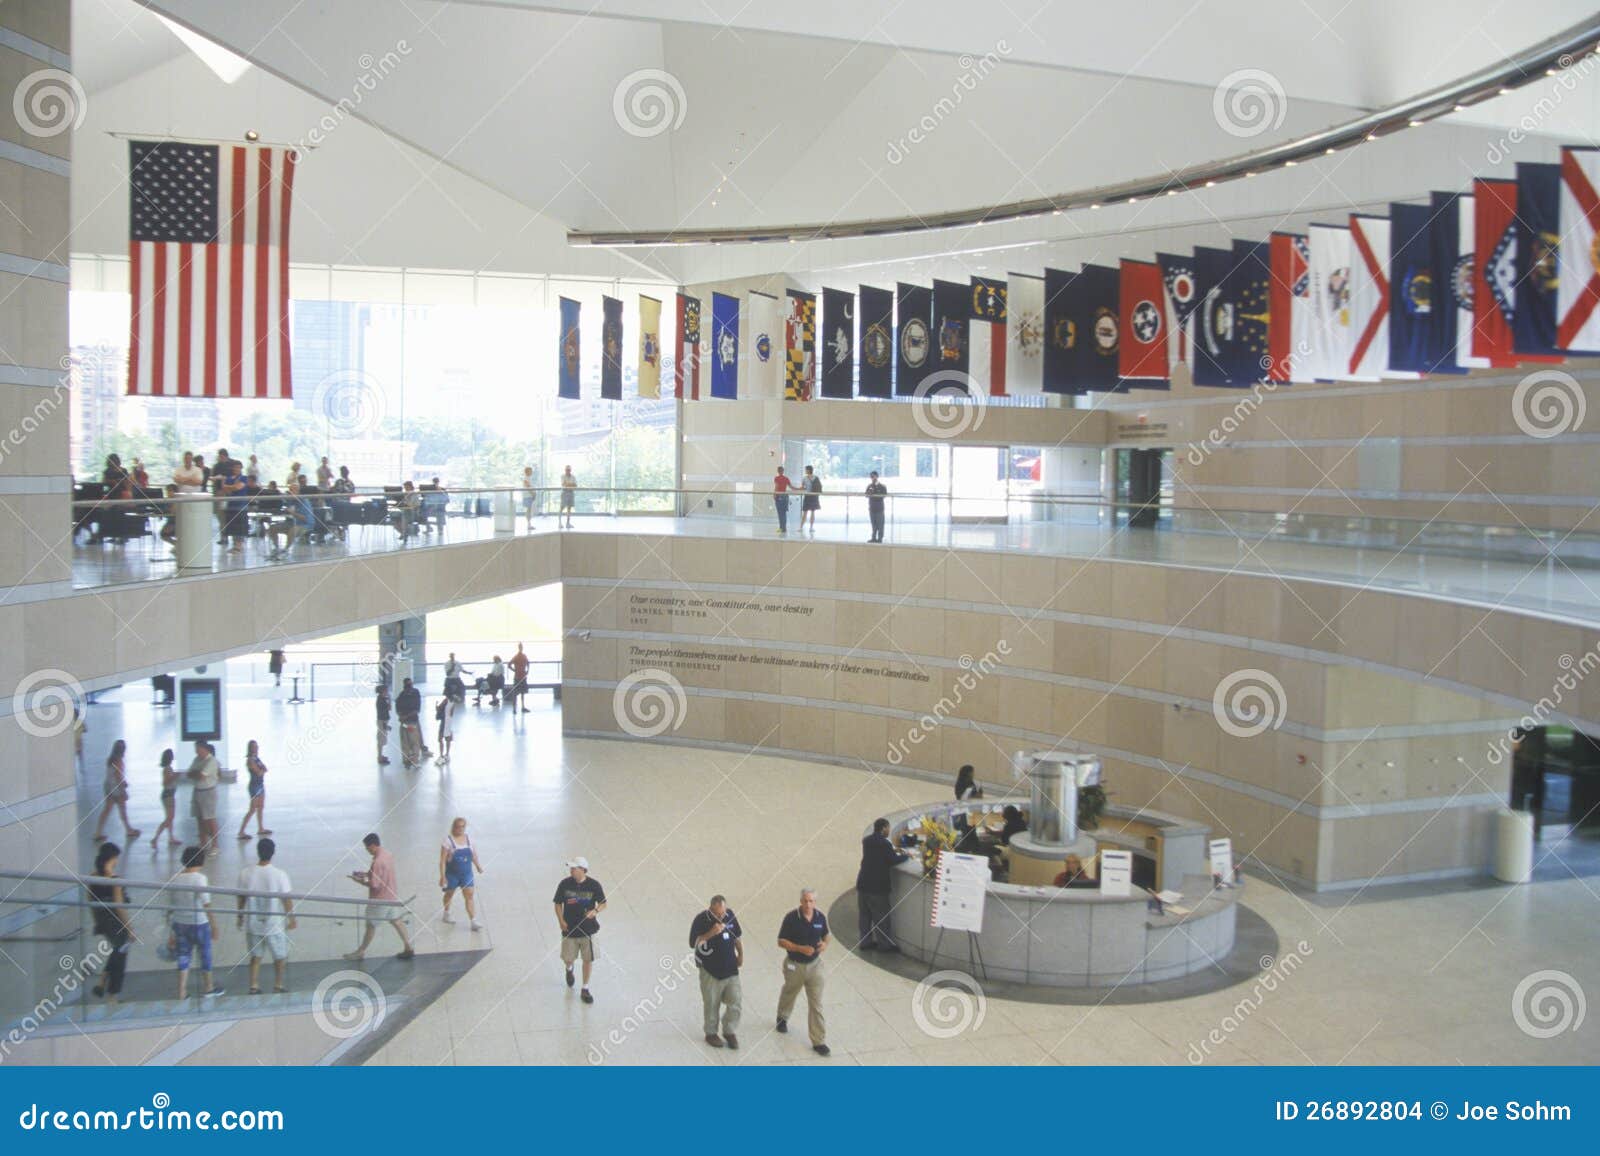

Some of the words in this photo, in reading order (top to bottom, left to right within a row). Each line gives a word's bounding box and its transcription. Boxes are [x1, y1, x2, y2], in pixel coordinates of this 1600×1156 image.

[630, 607, 663, 615] DANIEL
[667, 609, 708, 618] WEBSTER
[650, 597, 686, 608] country,
[705, 598, 762, 613] Constitution,
[764, 604, 782, 613] one
[783, 604, 815, 617] destiny
[629, 646, 645, 656] The
[644, 647, 673, 660] people
[673, 649, 718, 662] themselves
[718, 652, 737, 662] must
[738, 653, 749, 662] be
[750, 654, 764, 664] the
[764, 655, 799, 667] ultimate
[799, 658, 829, 670] makers
[840, 662, 862, 674] their
[862, 666, 880, 675] own
[880, 667, 929, 682] Constitution
[630, 658, 673, 668] THEODORE
[676, 661, 721, 672] ROOSEVELT
